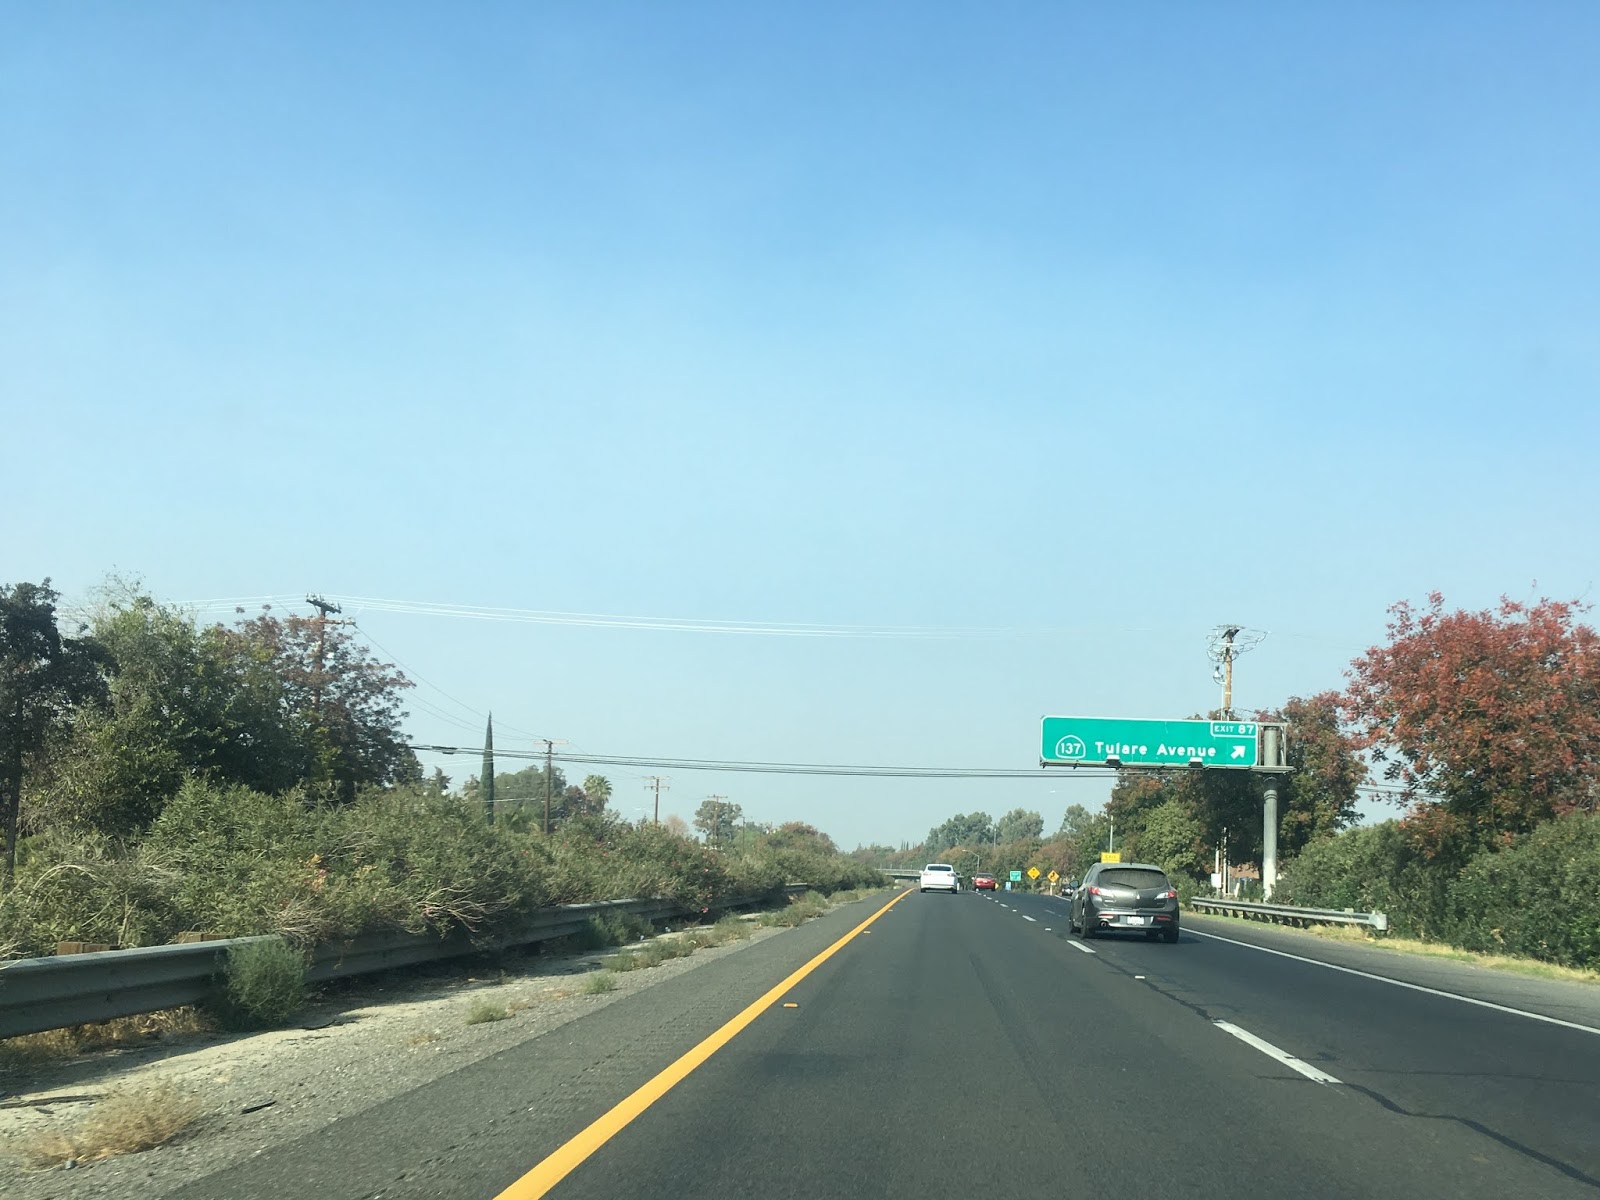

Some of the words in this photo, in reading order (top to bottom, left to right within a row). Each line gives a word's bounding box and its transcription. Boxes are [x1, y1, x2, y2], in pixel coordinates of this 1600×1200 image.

[1214, 725, 1234, 733] EXIT
[1238, 724, 1254, 734] 87
[1061, 742, 1081, 755] 137
[1094, 741, 1147, 756] Tulare
[1156, 743, 1217, 757] Avenue
